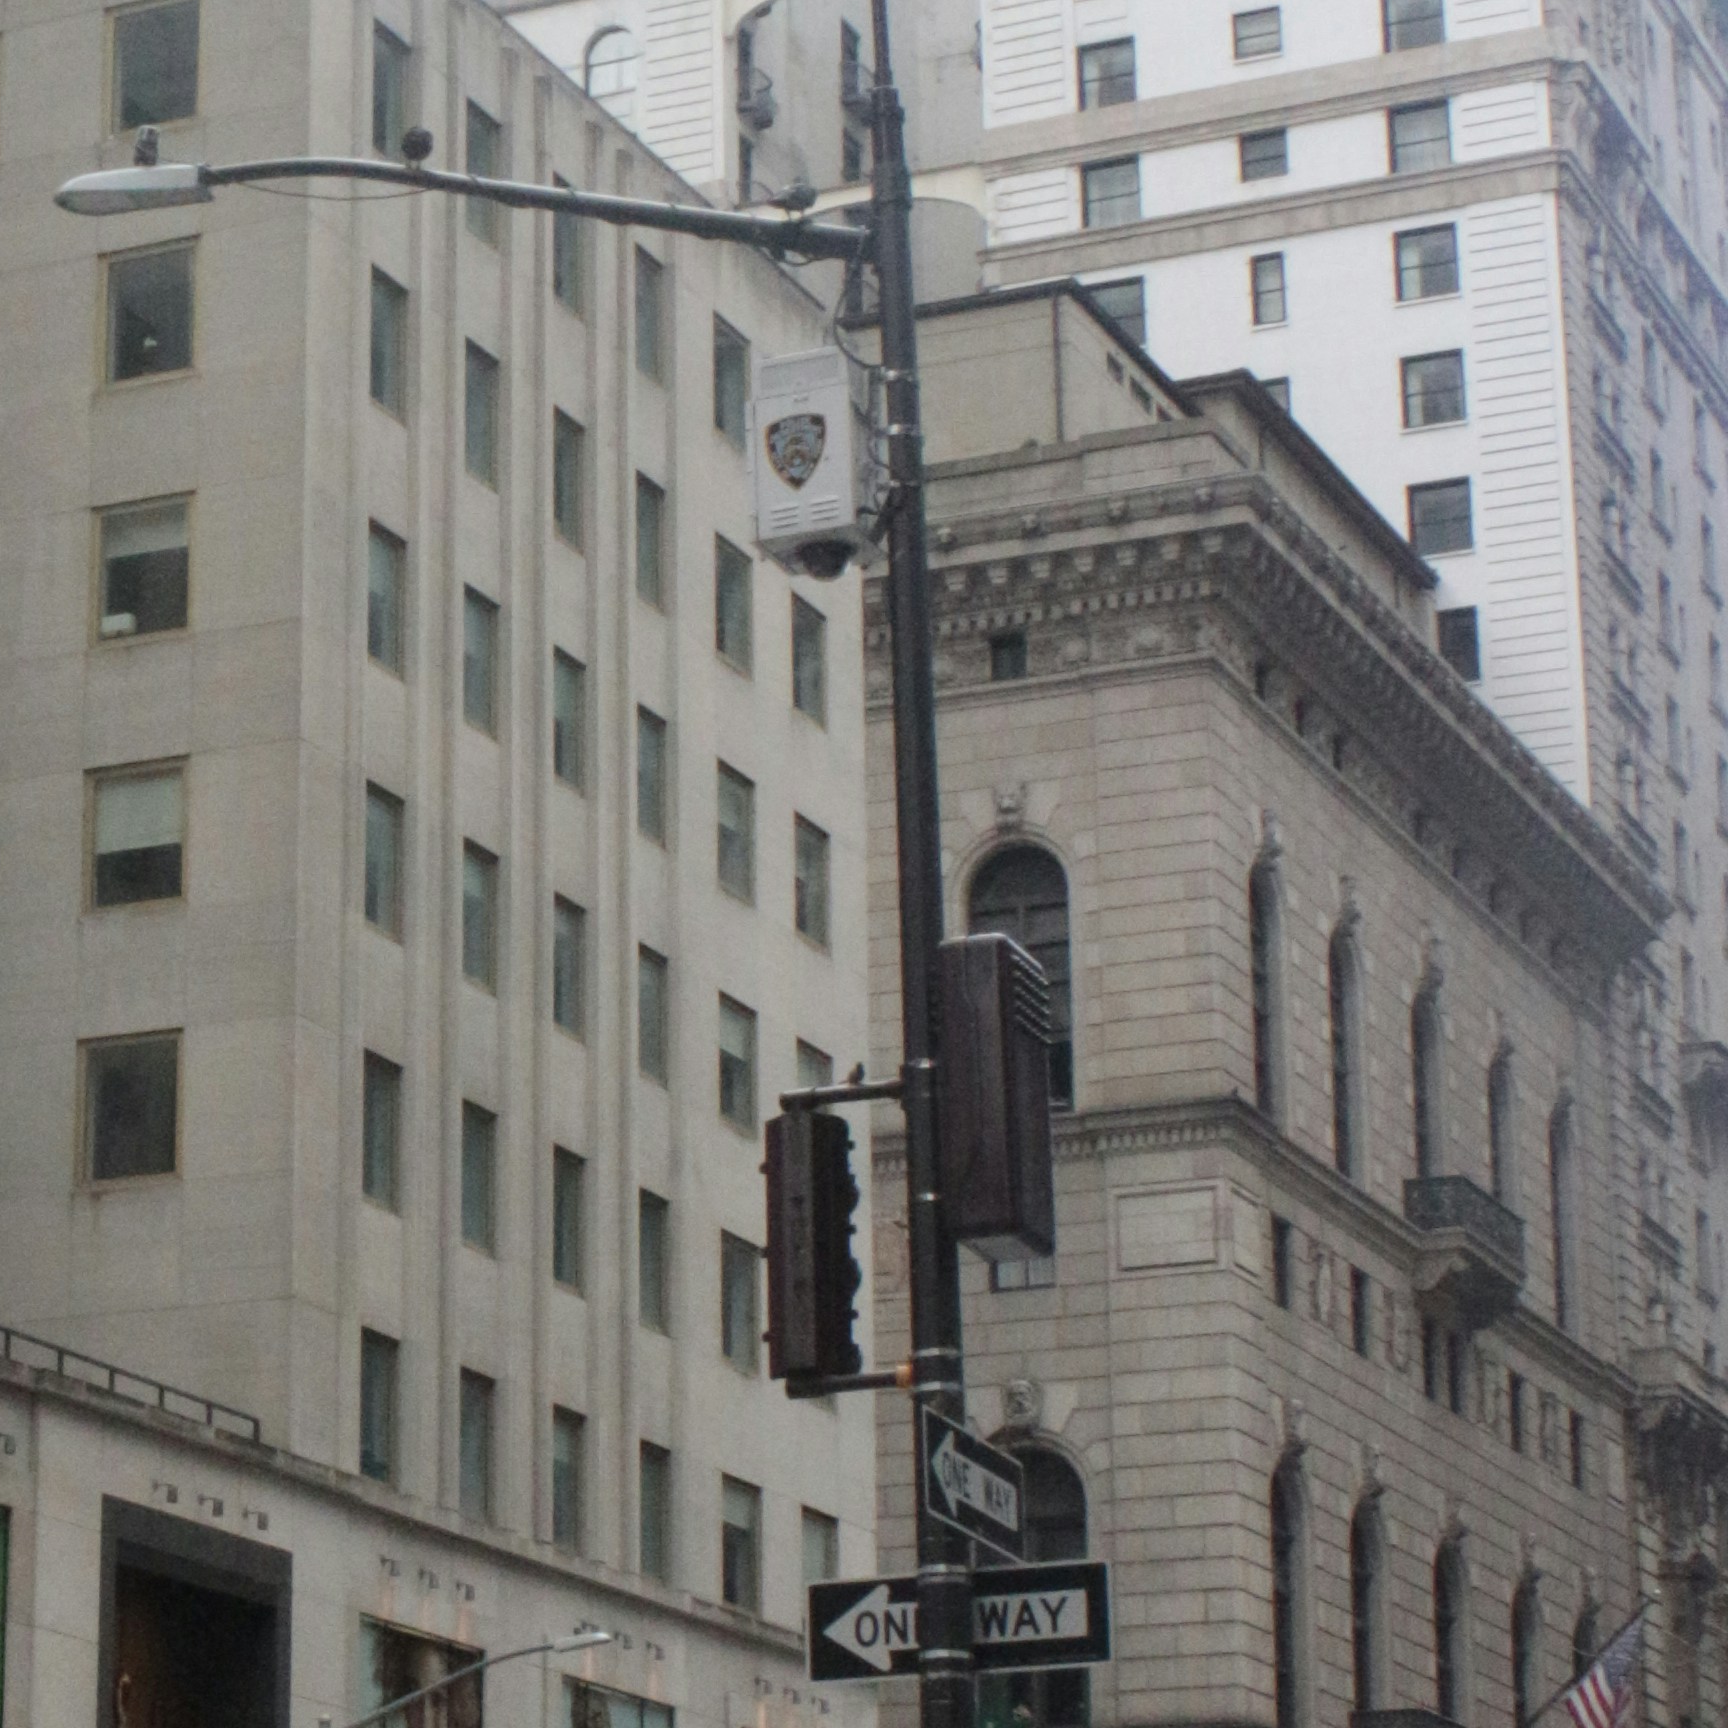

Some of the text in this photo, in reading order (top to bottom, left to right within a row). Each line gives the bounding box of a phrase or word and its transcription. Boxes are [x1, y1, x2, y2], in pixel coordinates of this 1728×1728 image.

[941, 1450, 1010, 1522] ONE WAY
[854, 1595, 1068, 1648] ON WAY
